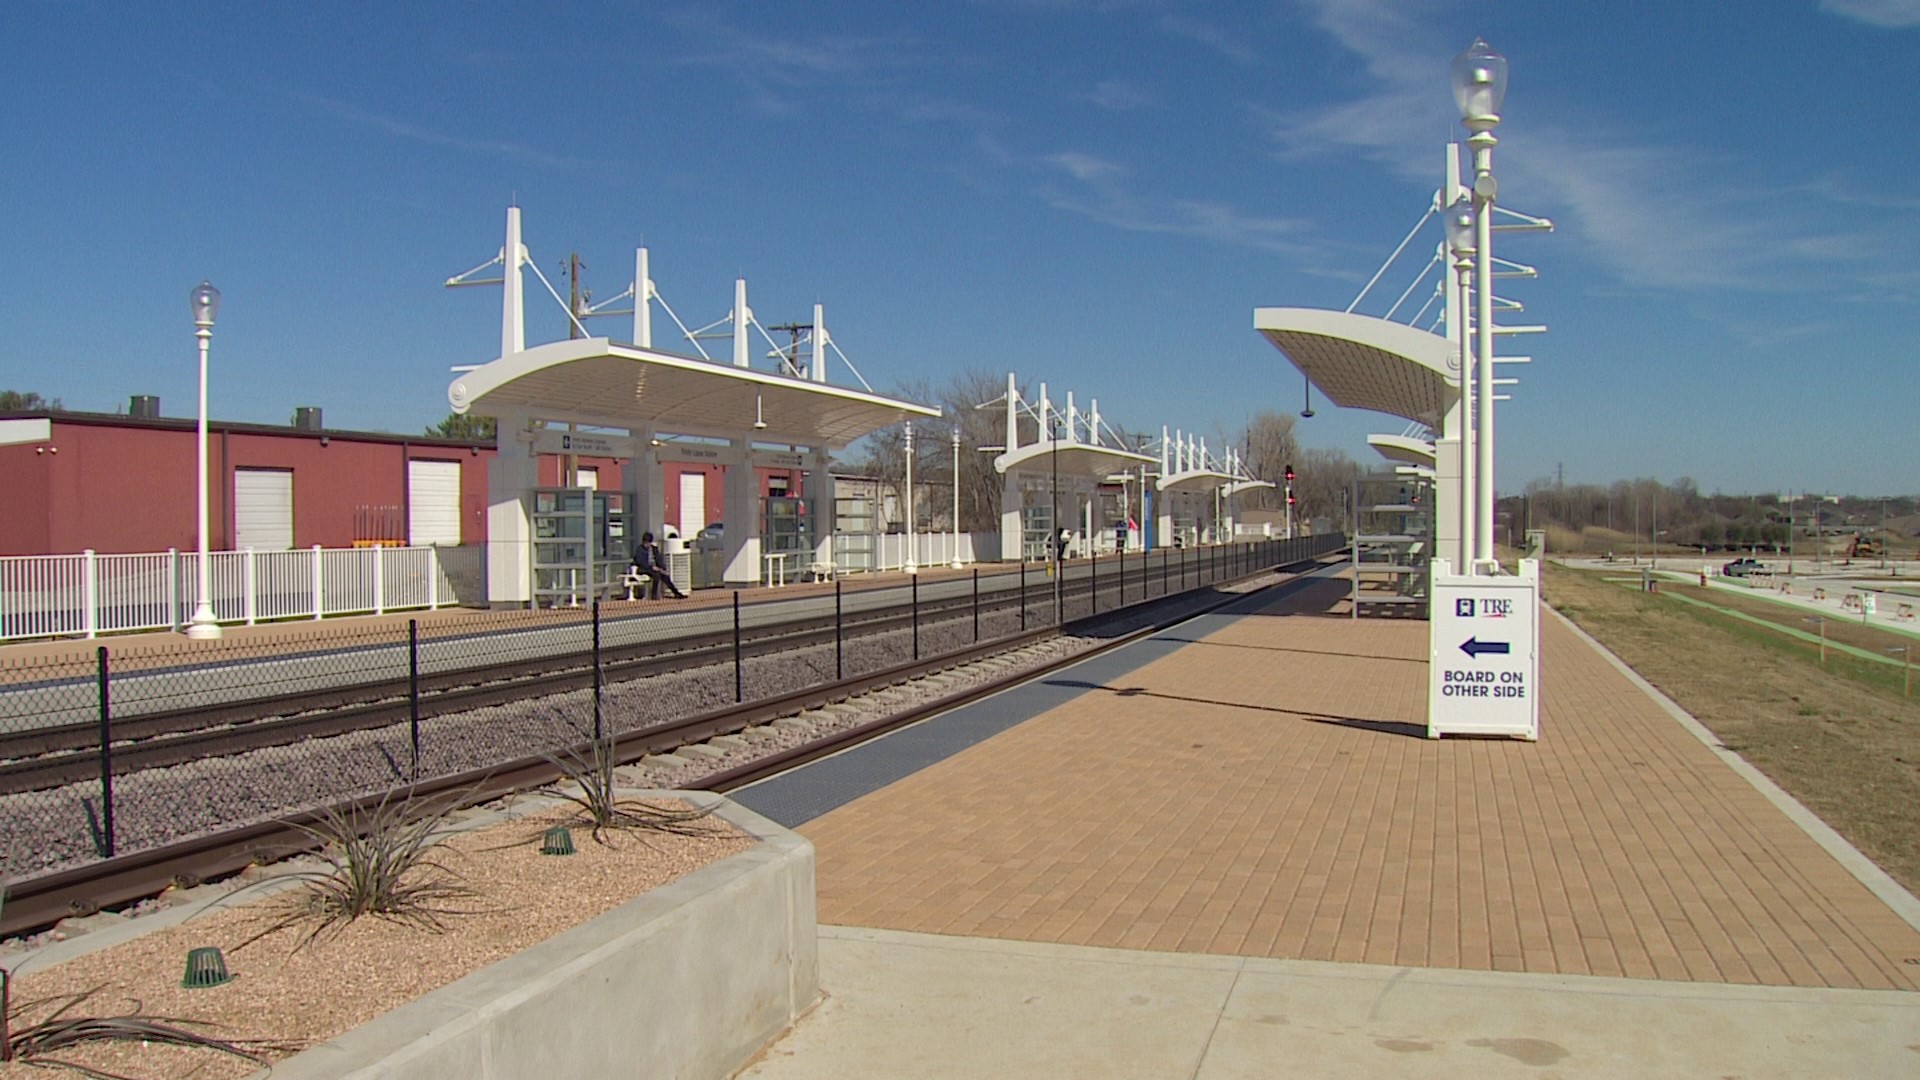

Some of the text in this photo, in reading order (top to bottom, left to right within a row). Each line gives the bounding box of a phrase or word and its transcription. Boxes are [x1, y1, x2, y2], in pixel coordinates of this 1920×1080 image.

[1480, 598, 1513, 614] TRE
[1444, 670, 1523, 684] BOARD ON
[1442, 684, 1525, 698] OTHER SIDE
